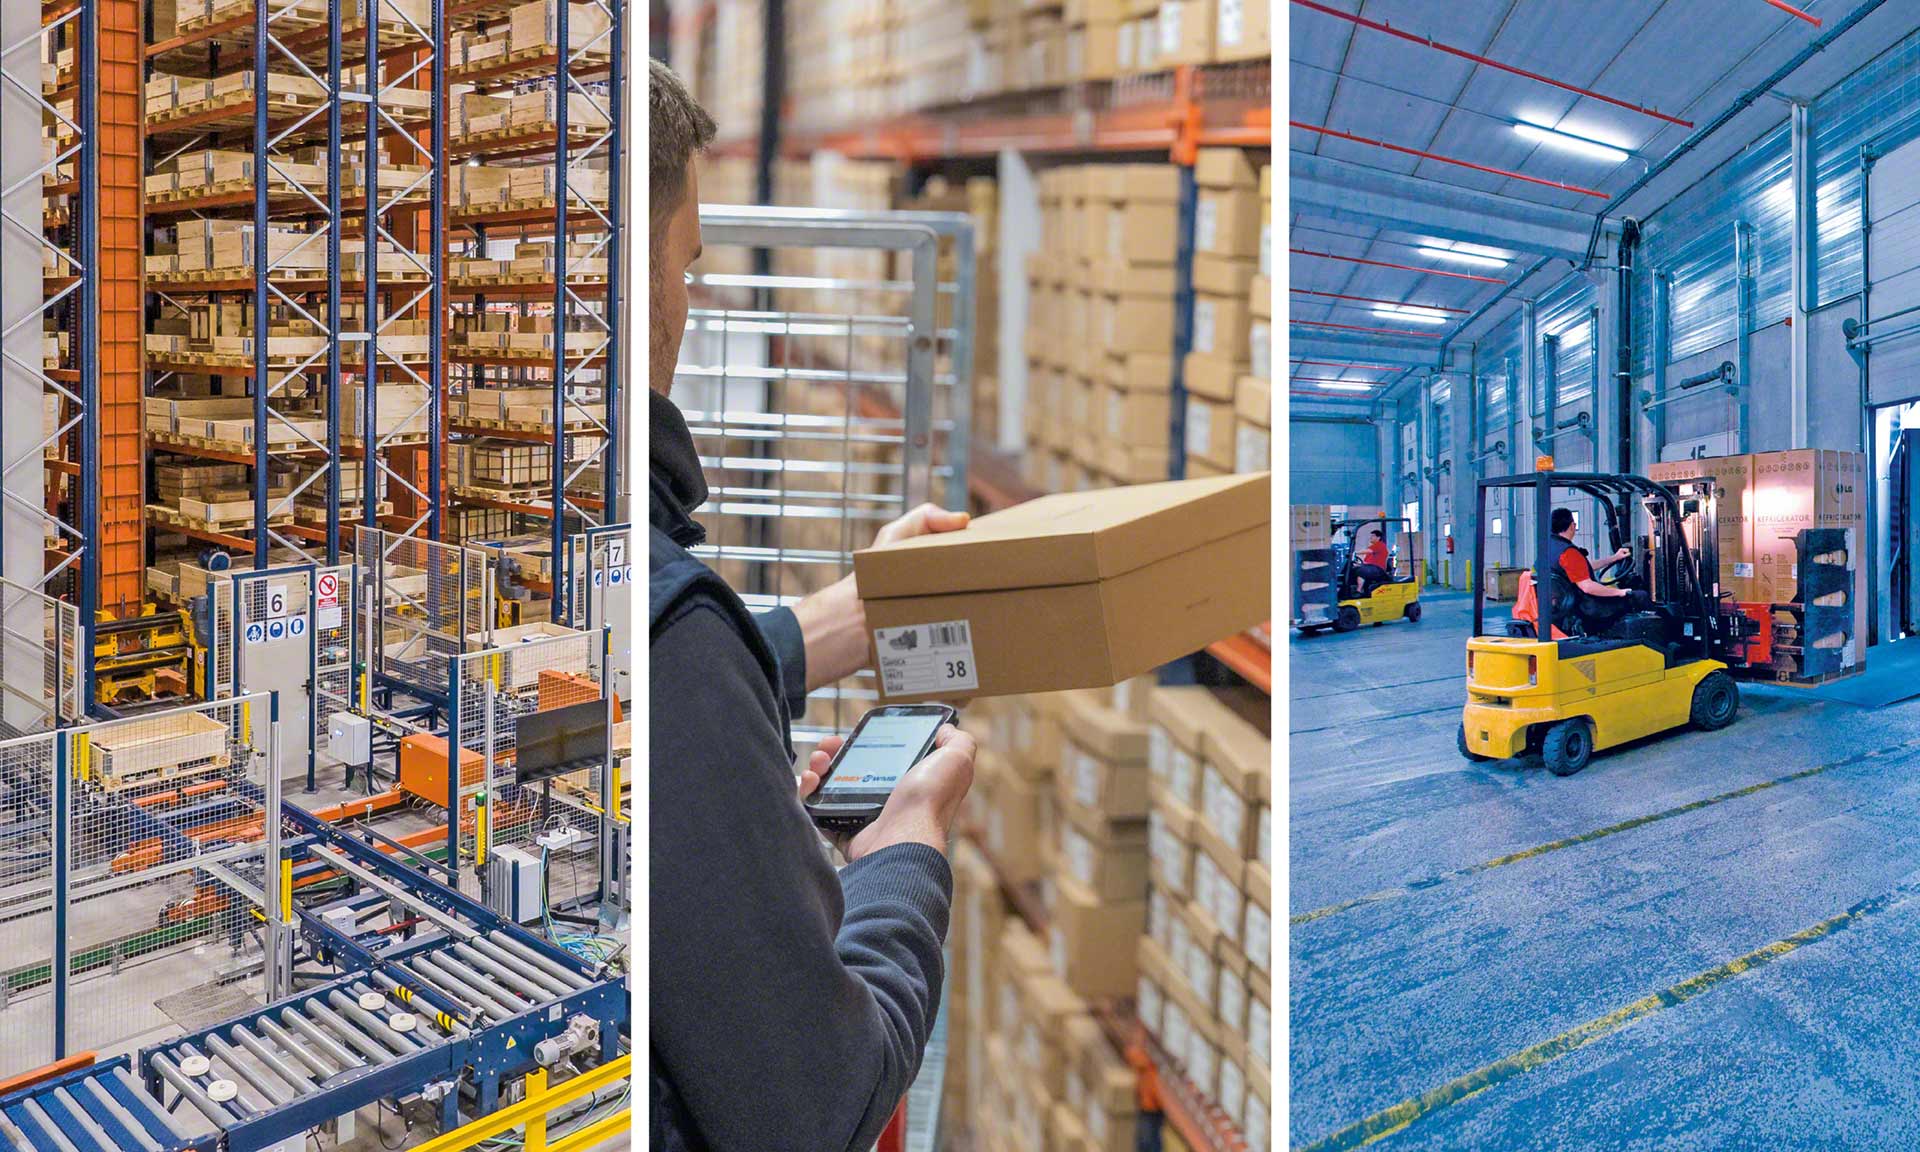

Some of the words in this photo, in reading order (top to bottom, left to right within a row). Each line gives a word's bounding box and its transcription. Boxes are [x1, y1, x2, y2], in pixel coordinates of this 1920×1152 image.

[612, 546, 621, 562] 7
[271, 593, 283, 613] 6
[945, 660, 967, 679] 38
